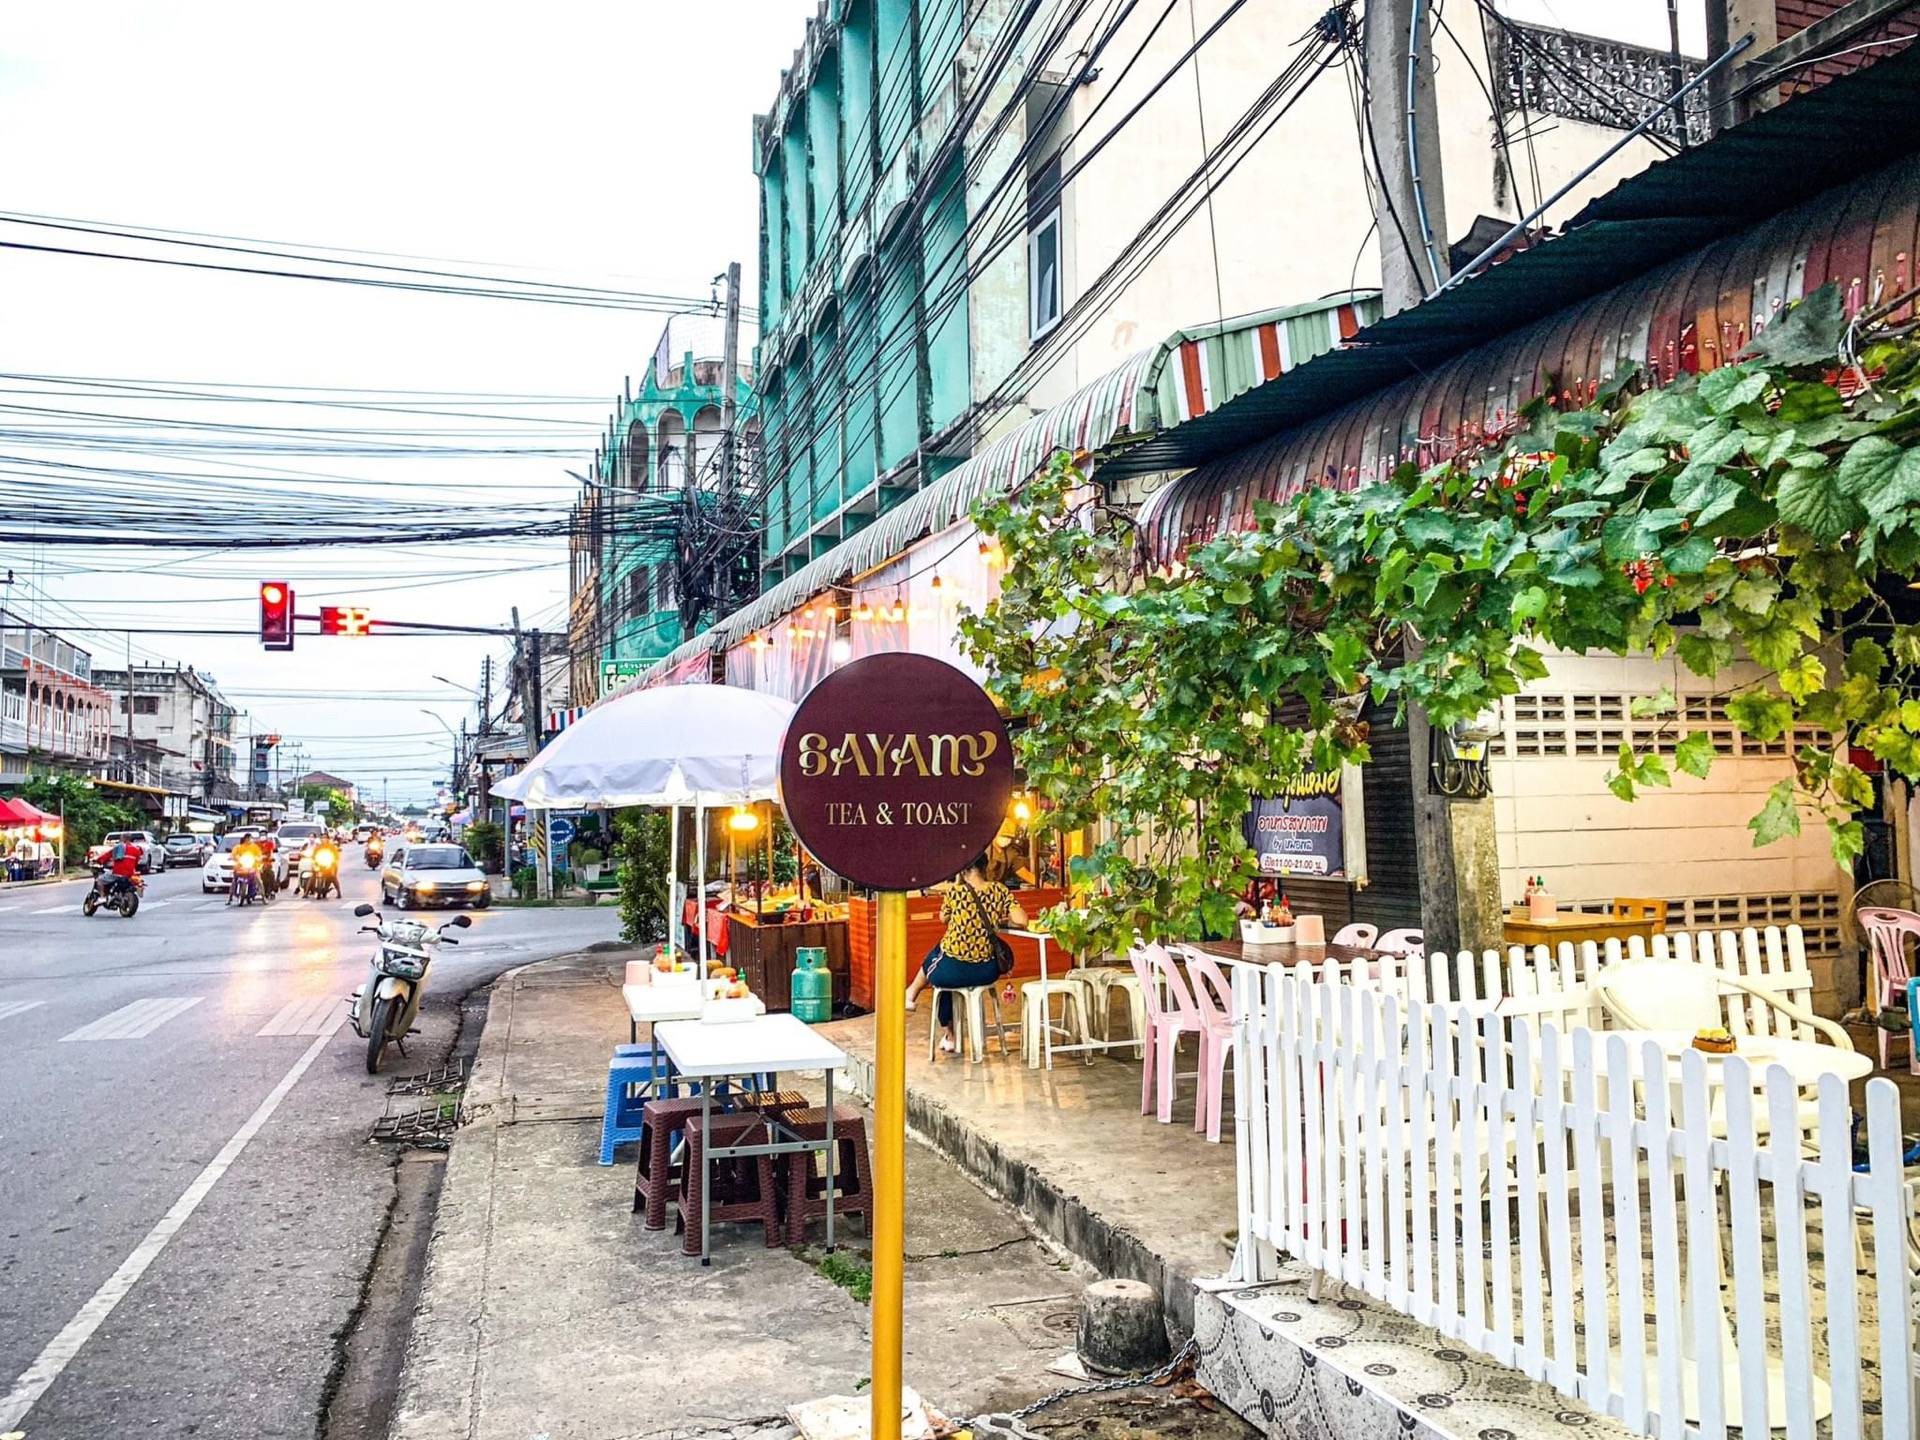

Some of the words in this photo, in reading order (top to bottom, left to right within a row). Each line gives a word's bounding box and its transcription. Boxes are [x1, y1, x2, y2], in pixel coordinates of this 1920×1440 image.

[798, 730, 998, 777] SAYAM
[825, 802, 868, 826] TEA
[875, 801, 894, 826] &
[901, 802, 973, 826] TOAST
